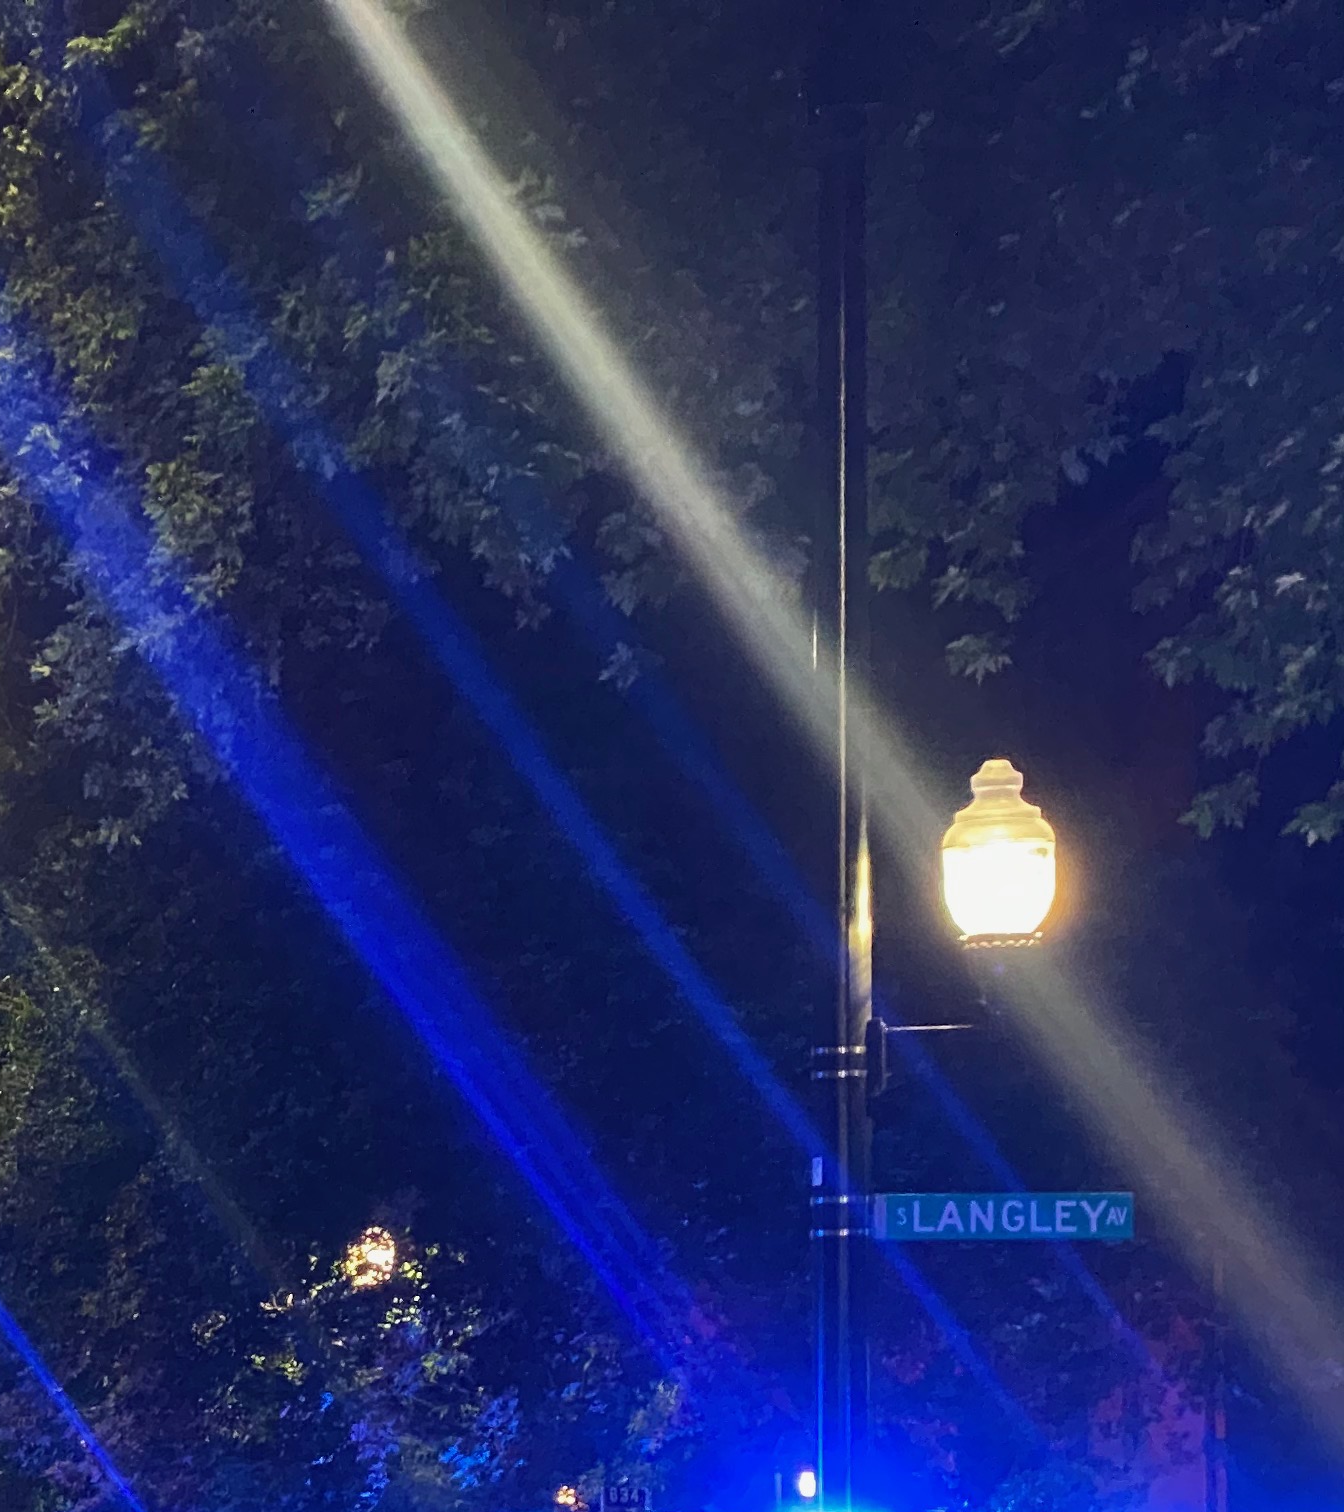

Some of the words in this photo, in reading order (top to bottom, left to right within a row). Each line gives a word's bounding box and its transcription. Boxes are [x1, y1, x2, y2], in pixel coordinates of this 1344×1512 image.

[896, 1207, 908, 1226] S
[913, 1200, 1108, 1233] LANGLEY
[1106, 1206, 1128, 1226] AV
